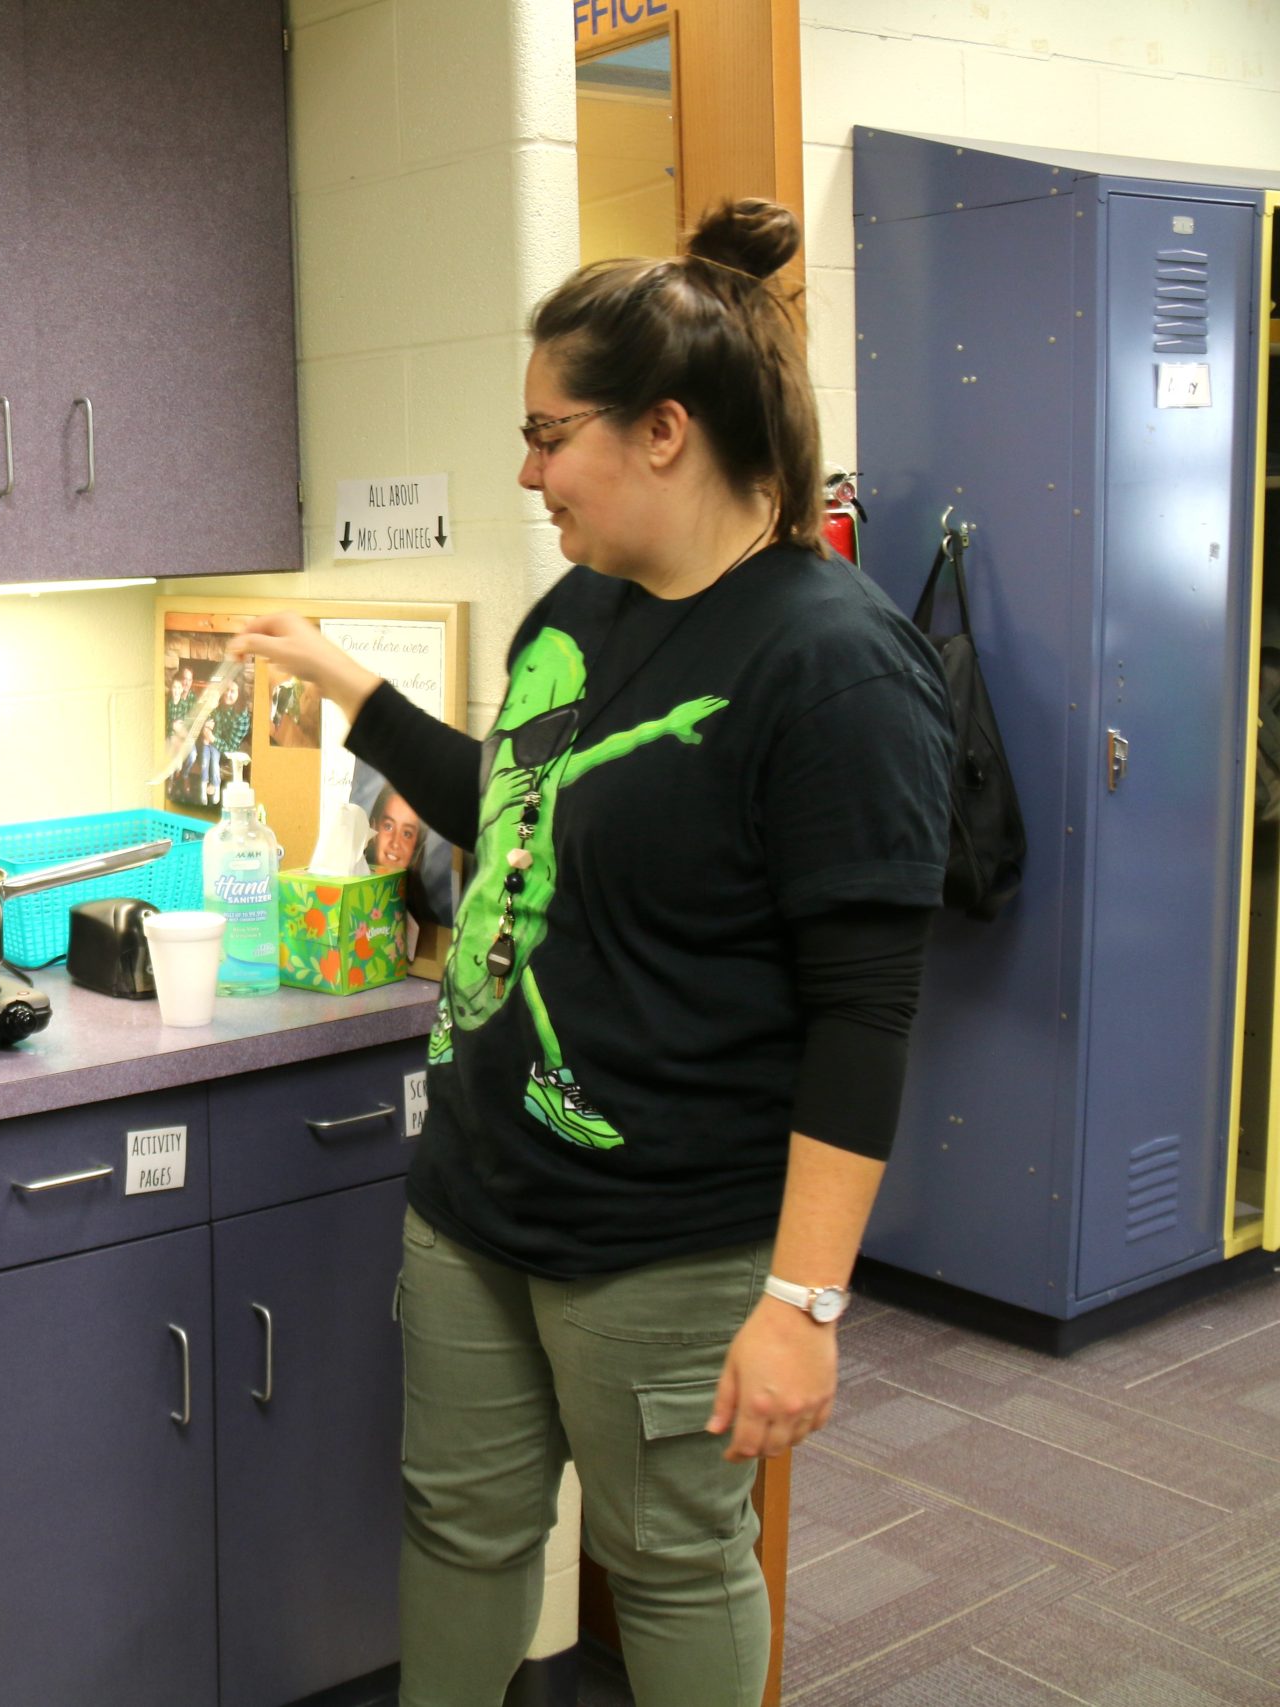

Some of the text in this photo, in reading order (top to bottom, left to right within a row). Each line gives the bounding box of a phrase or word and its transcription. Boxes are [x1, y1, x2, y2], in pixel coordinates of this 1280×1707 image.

[372, 635, 400, 653] there
[402, 642, 430, 654] were
[403, 673, 437, 691] whose
[215, 875, 270, 898] Hand
[227, 893, 272, 904] SANITIZER
